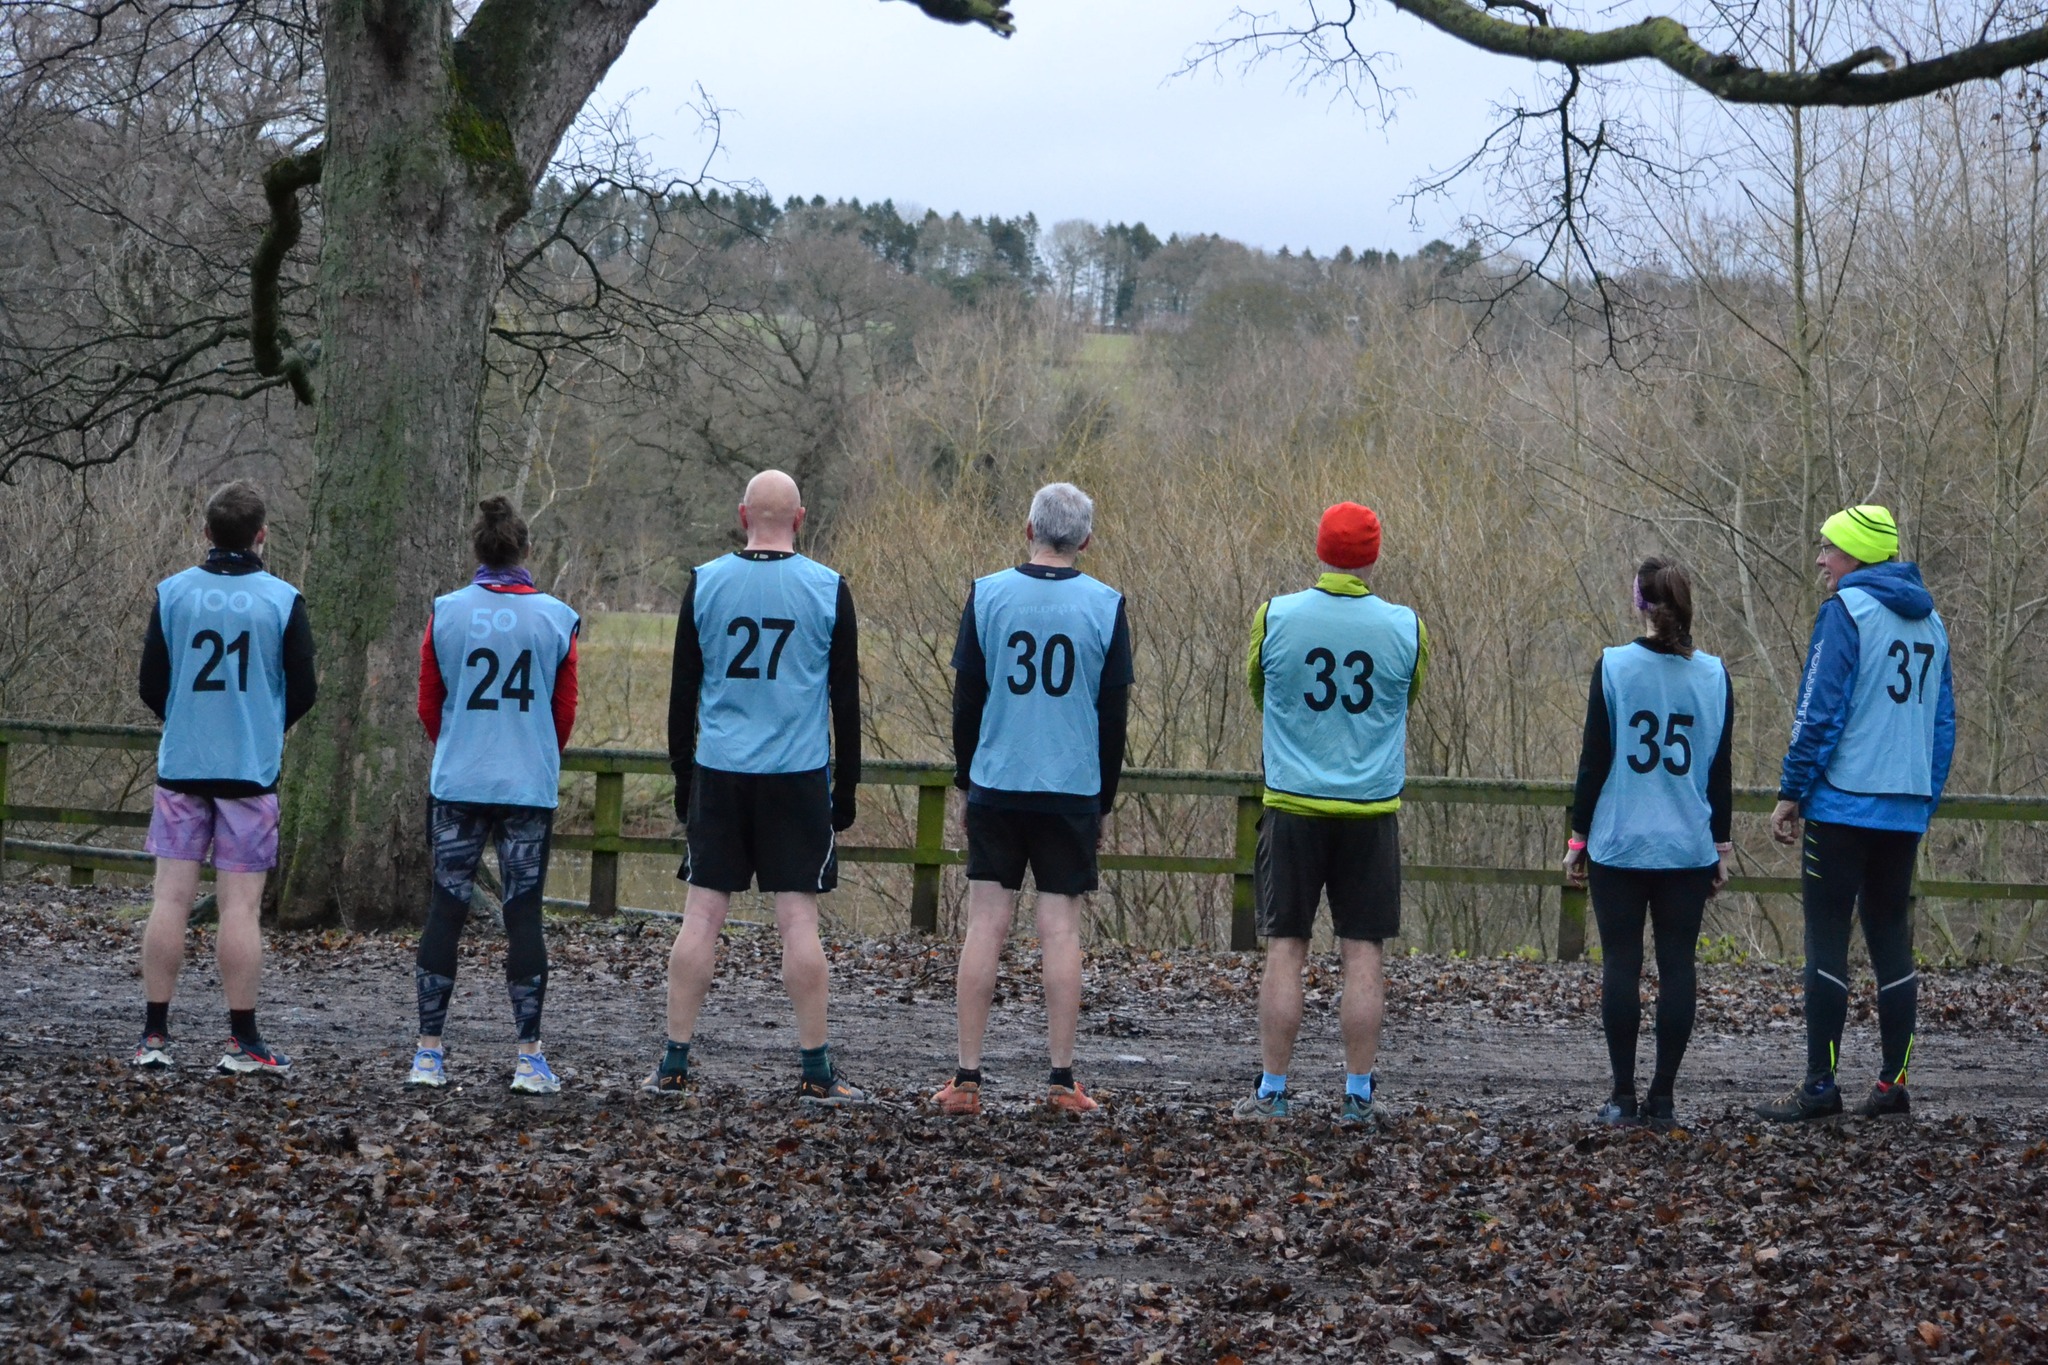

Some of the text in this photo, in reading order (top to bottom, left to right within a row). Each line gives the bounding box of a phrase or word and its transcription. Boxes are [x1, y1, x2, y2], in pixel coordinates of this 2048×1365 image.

[190, 588, 254, 618] 100
[470, 607, 518, 640] 50
[192, 629, 251, 693] 21
[466, 647, 536, 713] 24
[726, 616, 797, 681] 27
[1007, 630, 1077, 698] 30
[1887, 640, 1936, 705] 37
[1303, 647, 1376, 716] 33
[1626, 709, 1696, 777] 35
